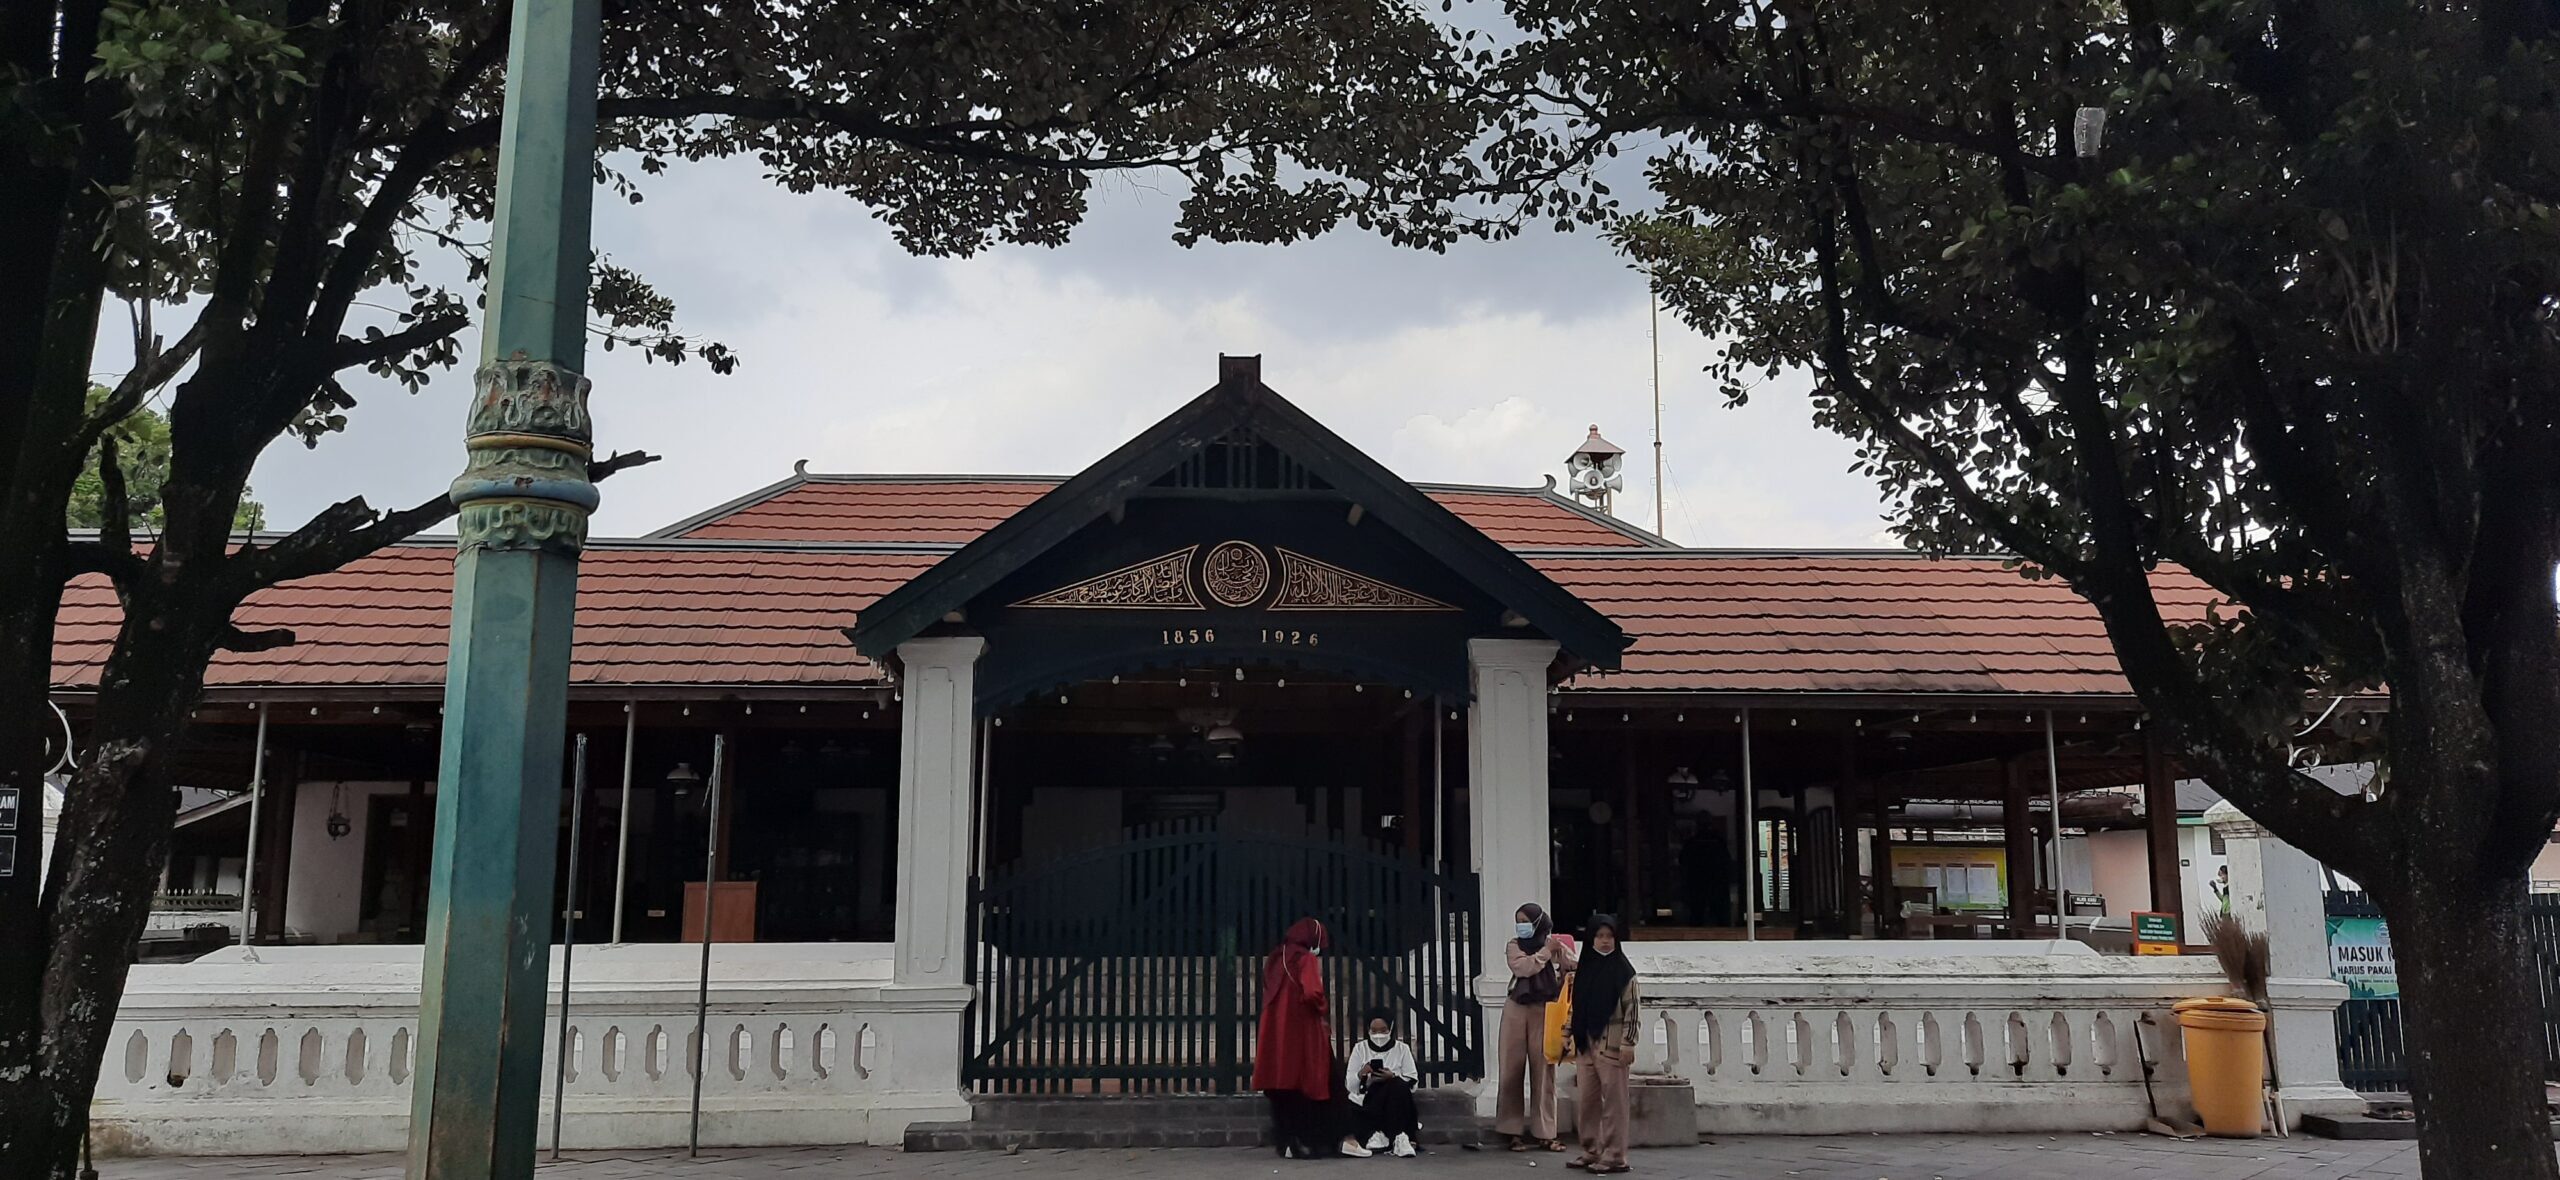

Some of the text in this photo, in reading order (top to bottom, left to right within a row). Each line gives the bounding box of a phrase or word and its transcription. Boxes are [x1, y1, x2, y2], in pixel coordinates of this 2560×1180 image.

[1162, 629, 1318, 646] 1856 1926
[2338, 946, 2384, 962] MASUK
[2337, 965, 2392, 975] HARUS PAKAI
